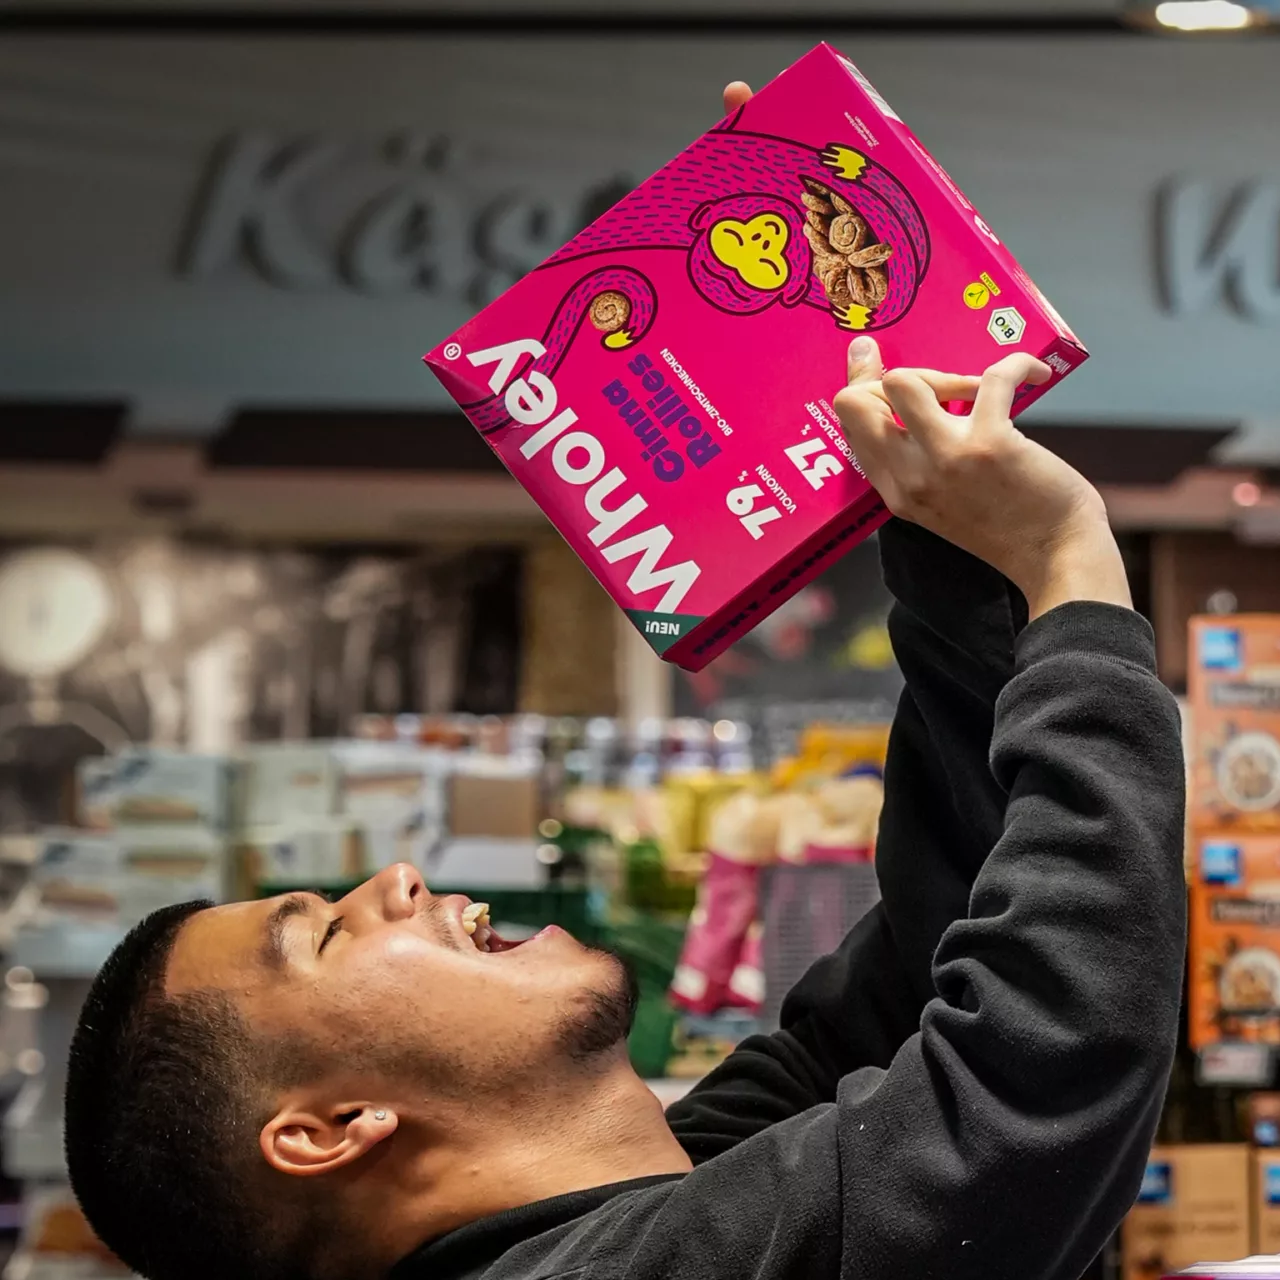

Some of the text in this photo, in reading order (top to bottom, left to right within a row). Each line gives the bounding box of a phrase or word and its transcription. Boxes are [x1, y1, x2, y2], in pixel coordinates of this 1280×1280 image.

[982, 274, 998, 294] VEGAN
[628, 353, 722, 470] Rollies
[660, 348, 733, 436] BIO-ZIMTSCHNECKEN
[601, 379, 685, 485] Cinna
[784, 424, 844, 491] 37%
[726, 470, 783, 540] 79%
[755, 464, 797, 514] VOLLKORN
[645, 620, 680, 636] NEU!
